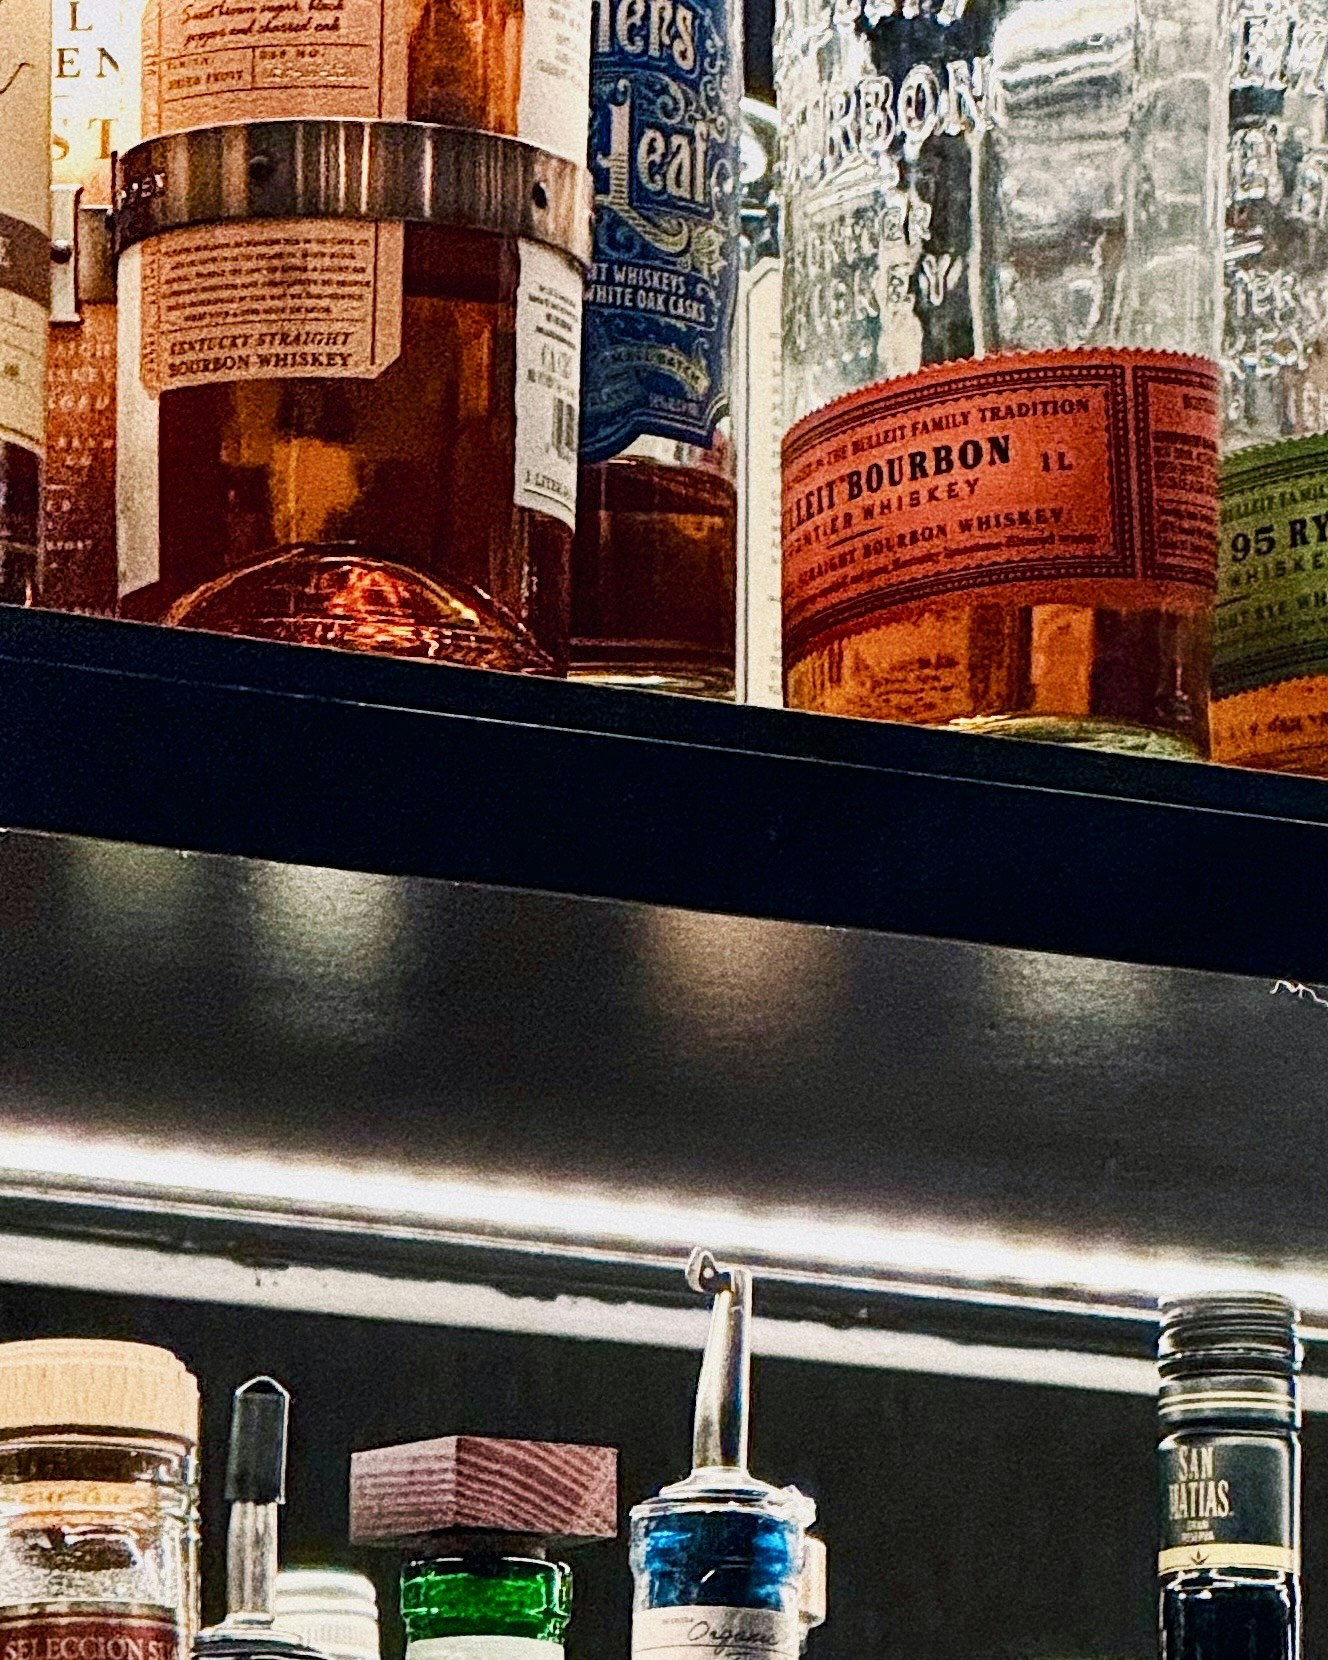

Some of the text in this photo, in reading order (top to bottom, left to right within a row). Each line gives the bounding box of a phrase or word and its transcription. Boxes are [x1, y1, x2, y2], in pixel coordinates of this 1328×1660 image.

[613, 264, 686, 296] WHISKEYS
[636, 289, 666, 313] OAK
[256, 331, 355, 347] STRAIGHT
[258, 352, 353, 369] WHISKEY
[911, 410, 971, 438] FAMILY
[978, 398, 1090, 423] TRADITION
[847, 433, 1011, 502] BOURBON
[1040, 451, 1074, 473] 1L
[862, 476, 982, 522] WHISKEY
[862, 507, 1065, 559] BOURBON WHISKEY
[1231, 525, 1276, 562] 95
[1178, 1444, 1215, 1481] SAN
[687, 1620, 781, 1655] Organic
